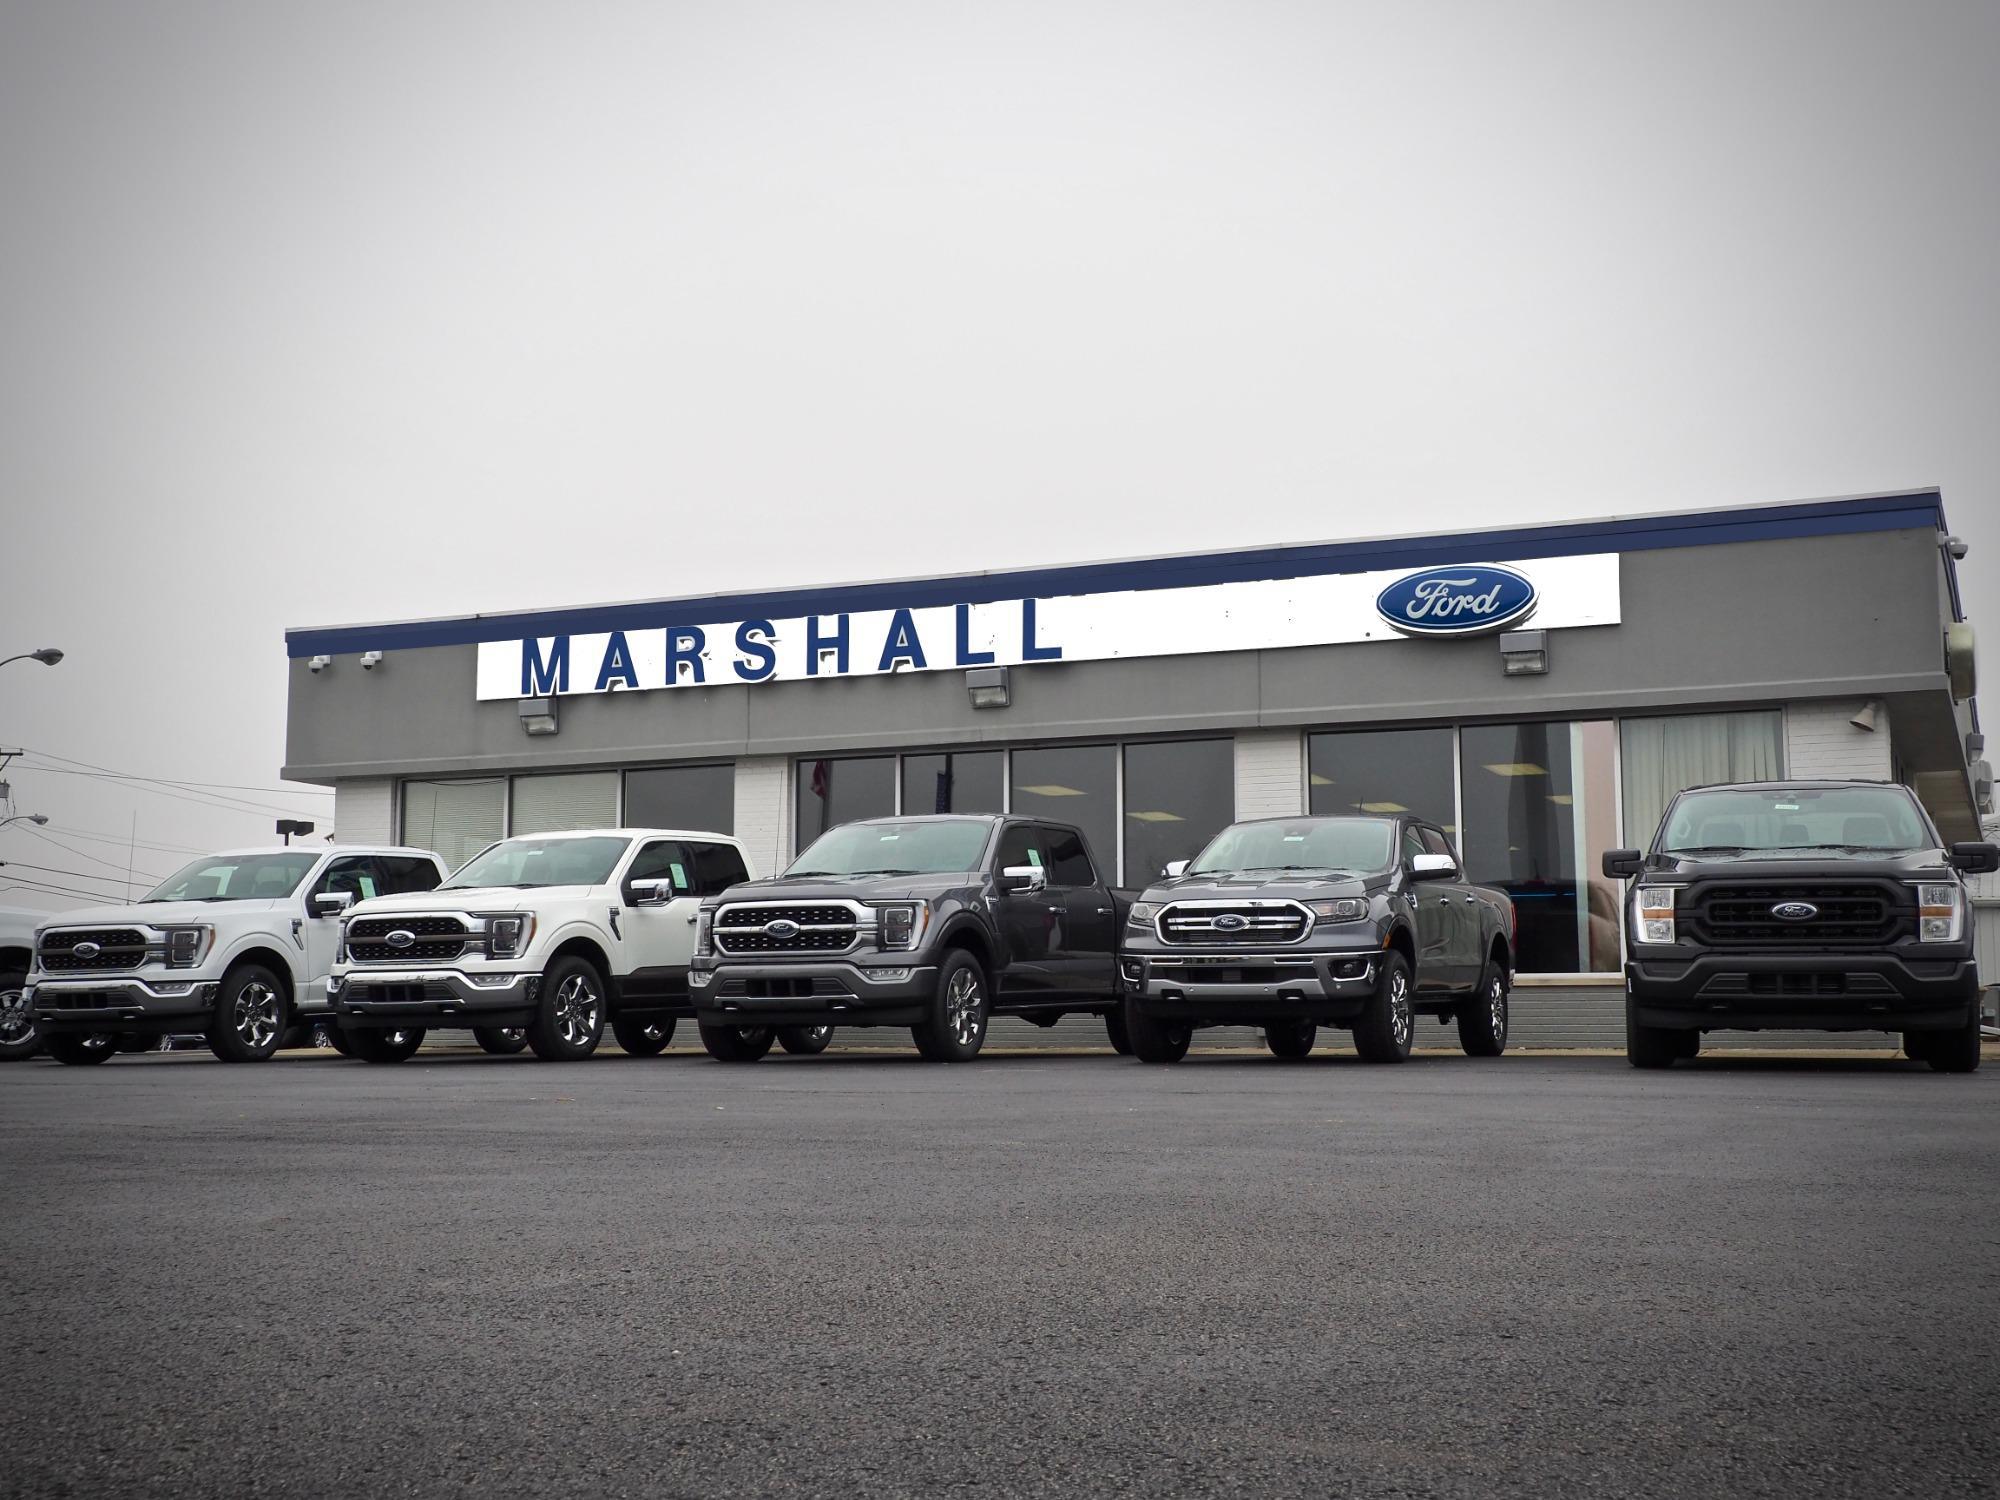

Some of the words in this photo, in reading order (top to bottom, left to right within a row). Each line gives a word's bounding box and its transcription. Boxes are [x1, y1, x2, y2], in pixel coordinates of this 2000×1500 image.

[1406, 577, 1502, 619] Ford
[521, 598, 1063, 695] MARSHALL
[1219, 917, 1239, 928] Ford
[1782, 905, 1807, 916] Ford
